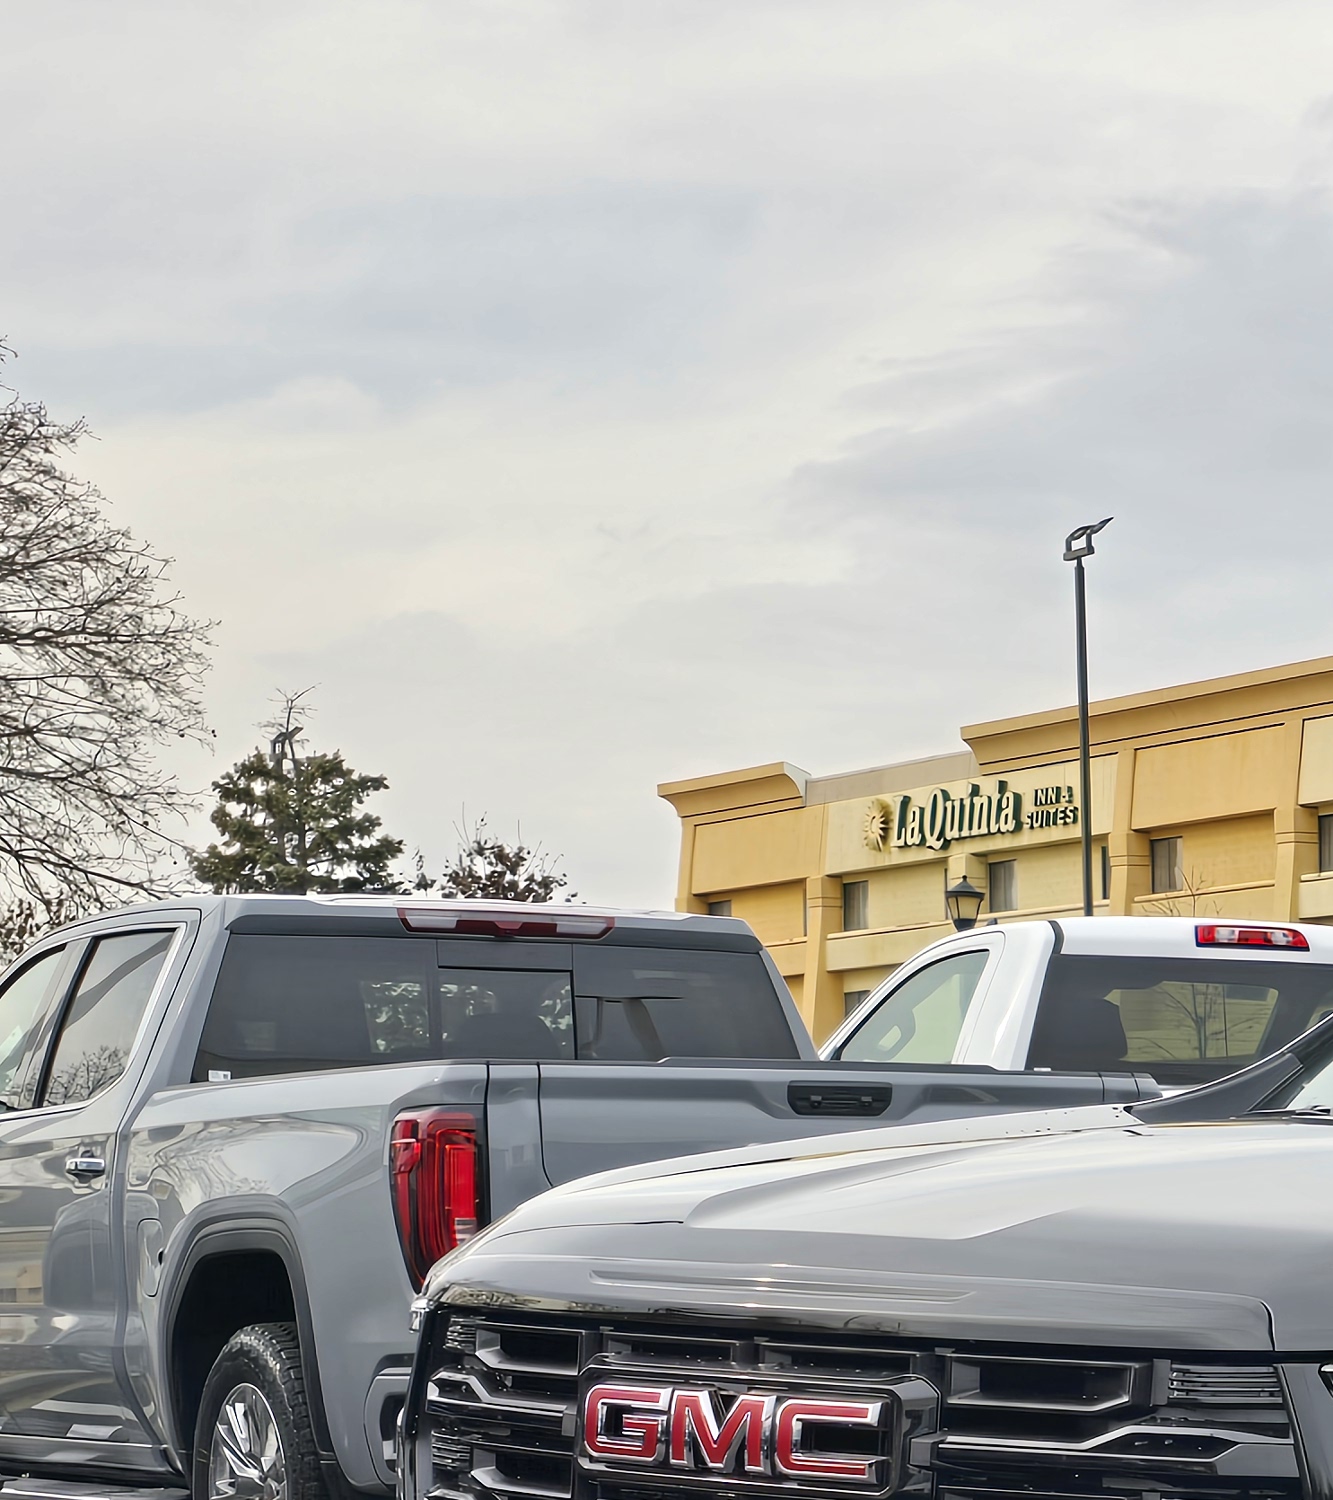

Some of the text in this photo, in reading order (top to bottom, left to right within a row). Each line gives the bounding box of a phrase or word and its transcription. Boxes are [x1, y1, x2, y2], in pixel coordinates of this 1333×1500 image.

[924, 780, 1023, 850] Quinta
[1025, 806, 1079, 829] SUITES
[584, 1383, 889, 1485] GMC
